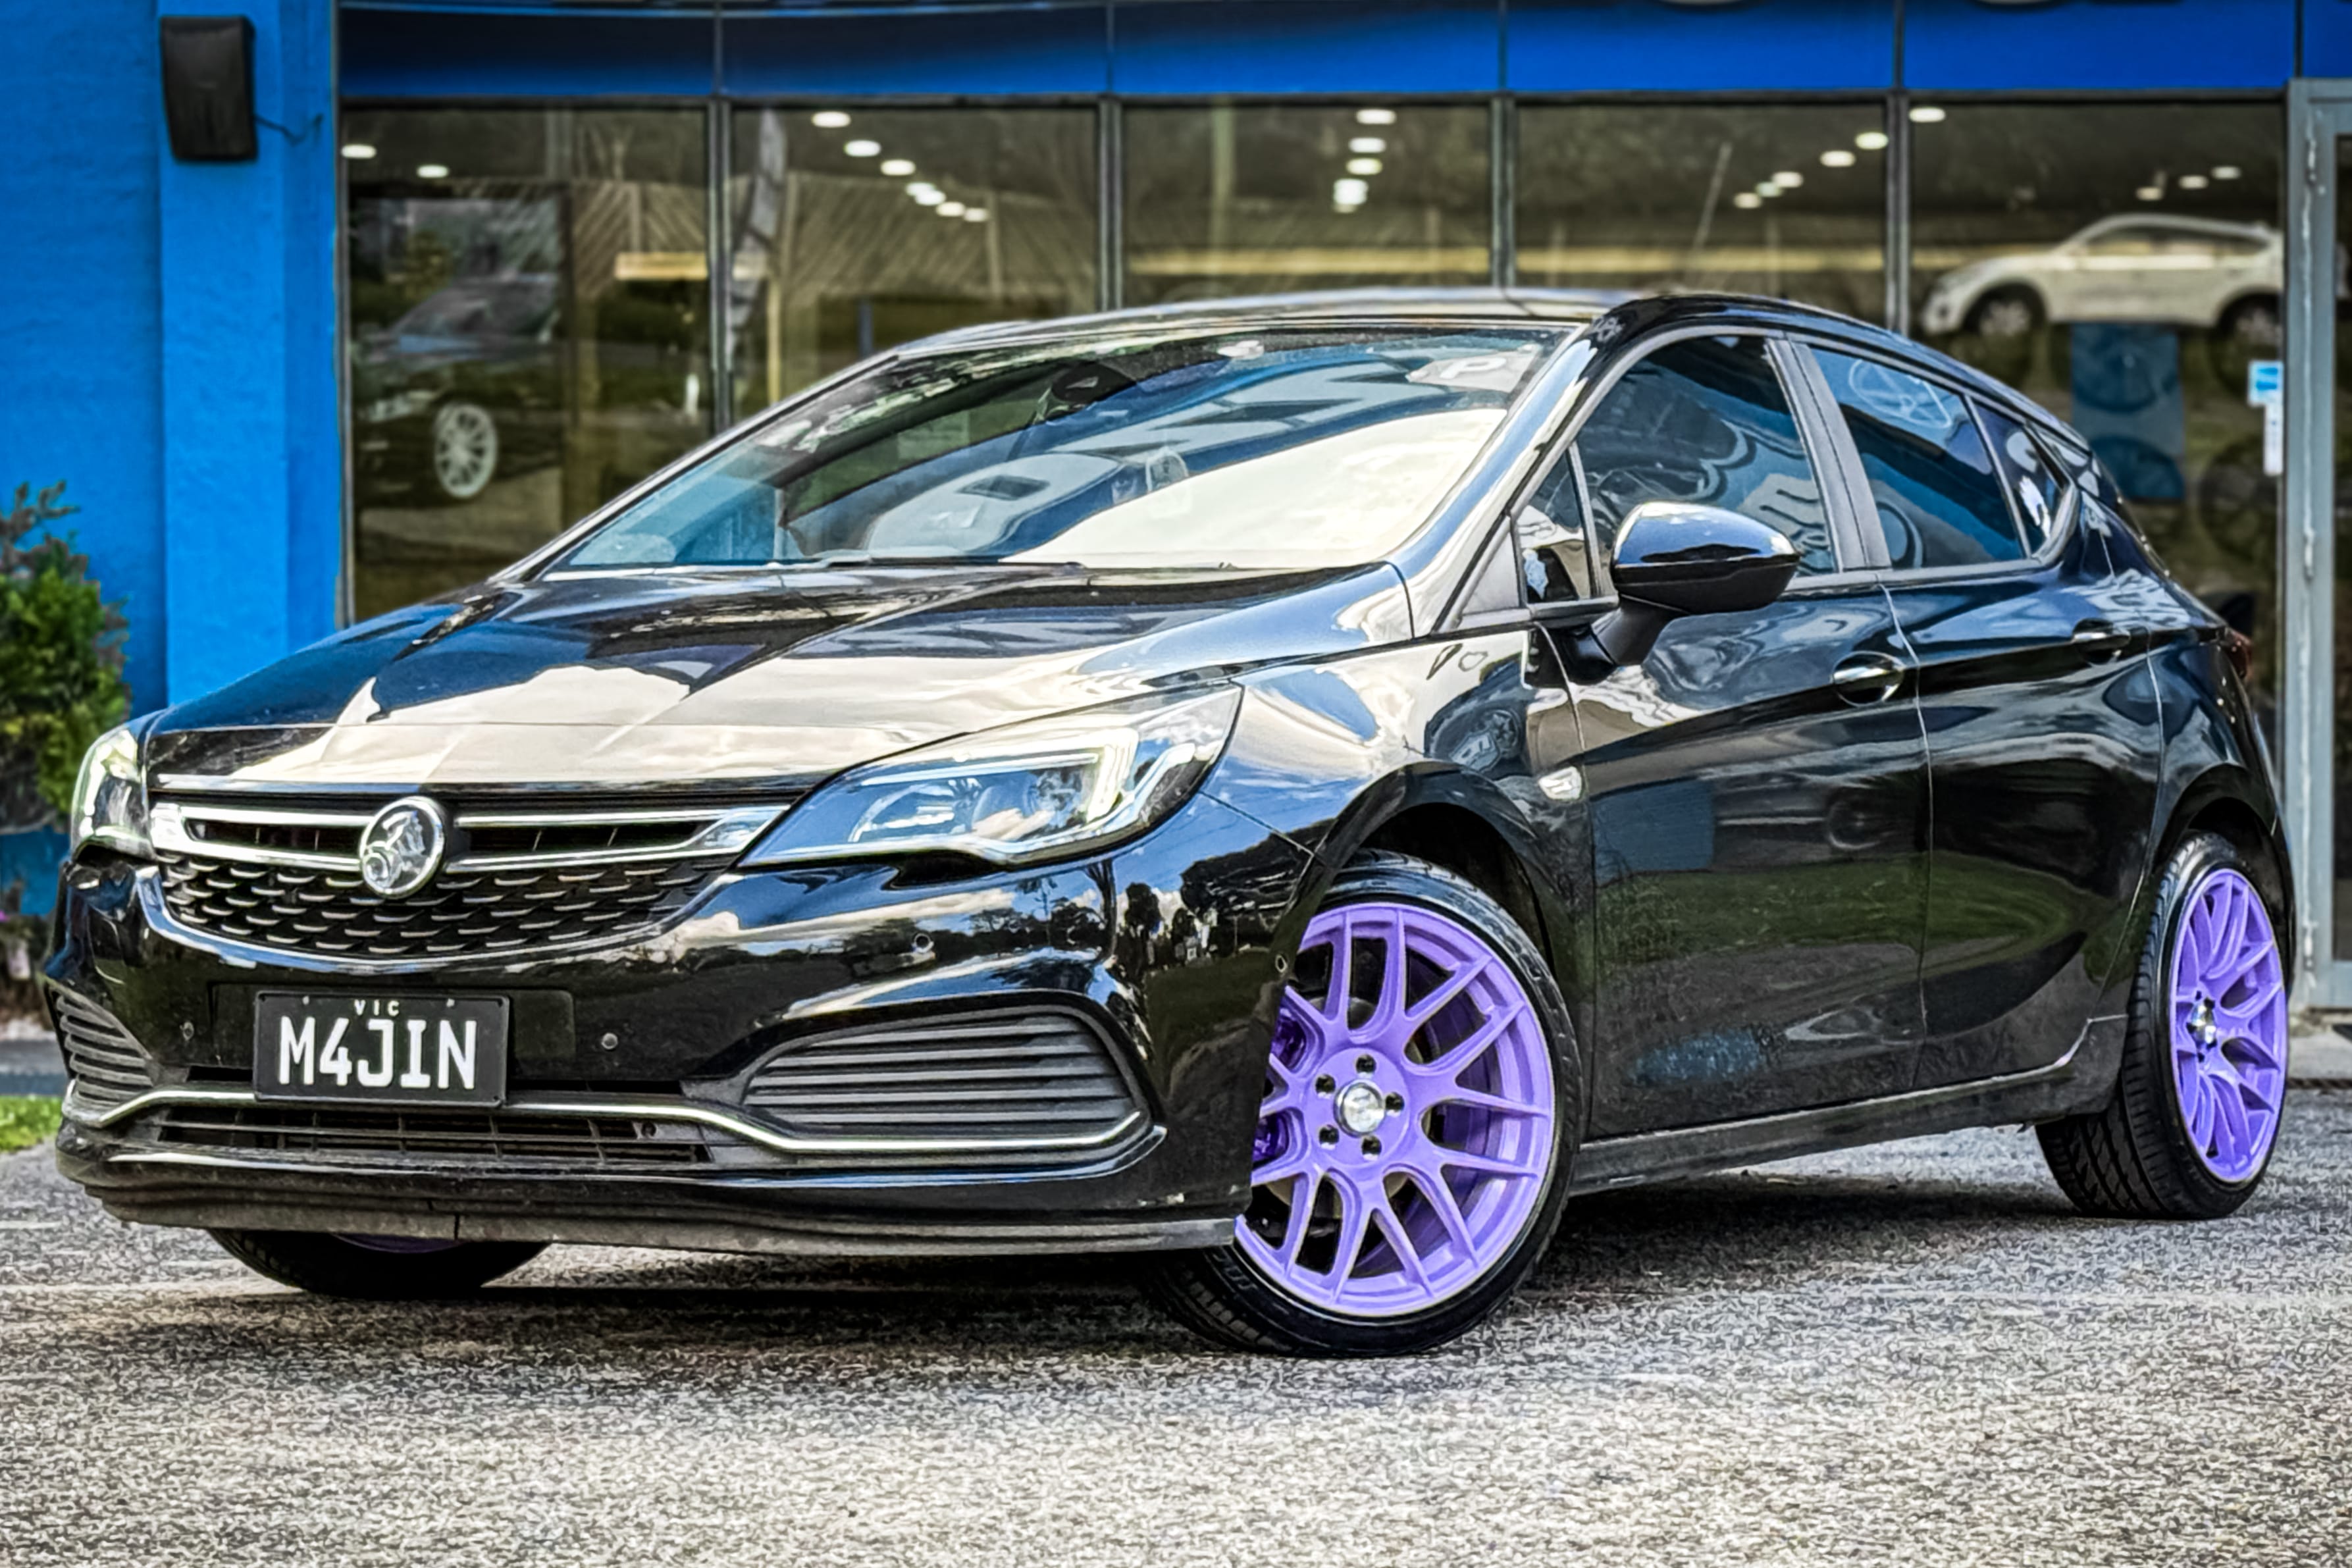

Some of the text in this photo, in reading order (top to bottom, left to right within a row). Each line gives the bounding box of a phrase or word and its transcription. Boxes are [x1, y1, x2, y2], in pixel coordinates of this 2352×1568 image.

[1439, 357, 1507, 380] P
[354, 999, 399, 1016] VIC
[278, 1016, 477, 1090] M4JIN
